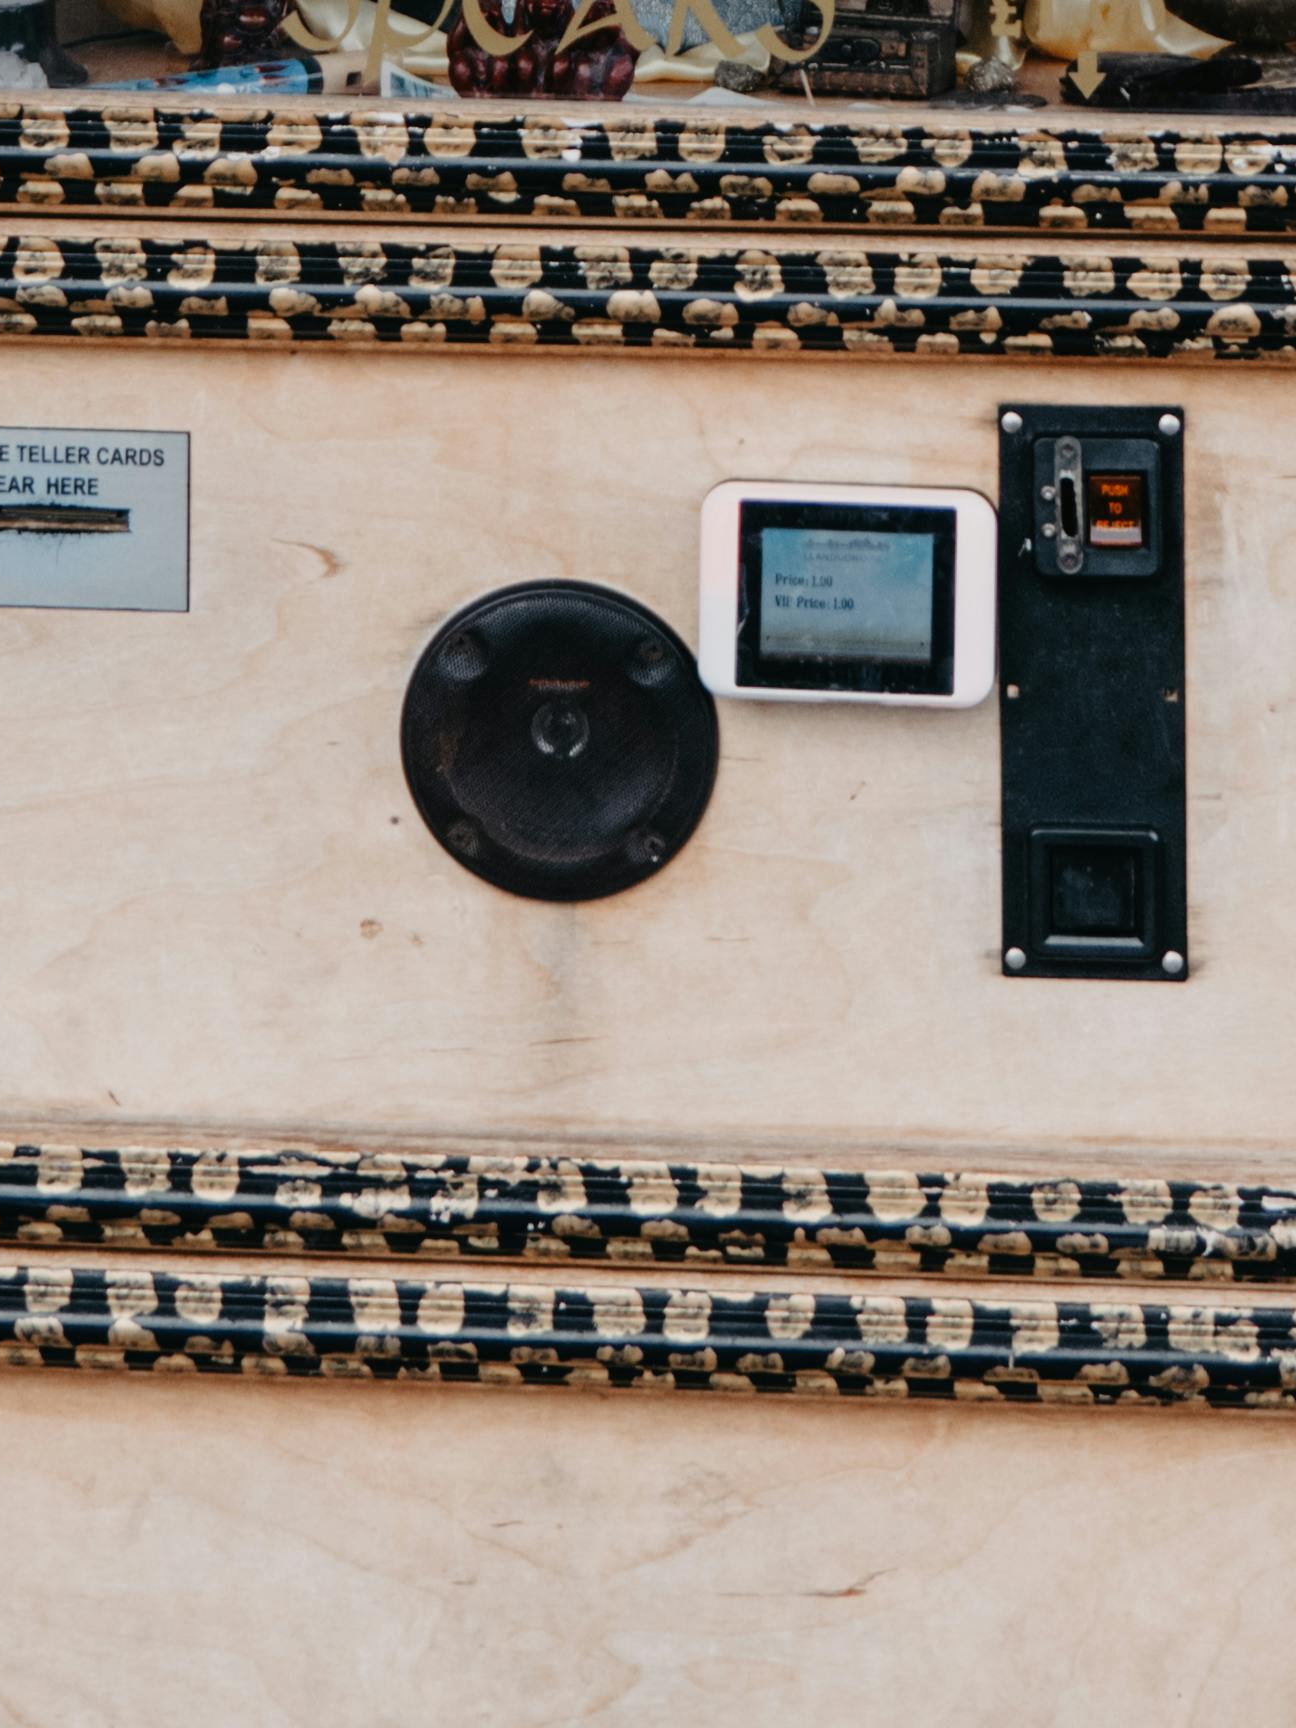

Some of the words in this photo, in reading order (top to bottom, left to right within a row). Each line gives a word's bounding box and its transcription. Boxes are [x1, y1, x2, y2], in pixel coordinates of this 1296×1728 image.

[16, 444, 91, 464] TELLER
[96, 446, 165, 467] CARDS
[46, 478, 100, 496] HERE
[1107, 501, 1124, 515] TO
